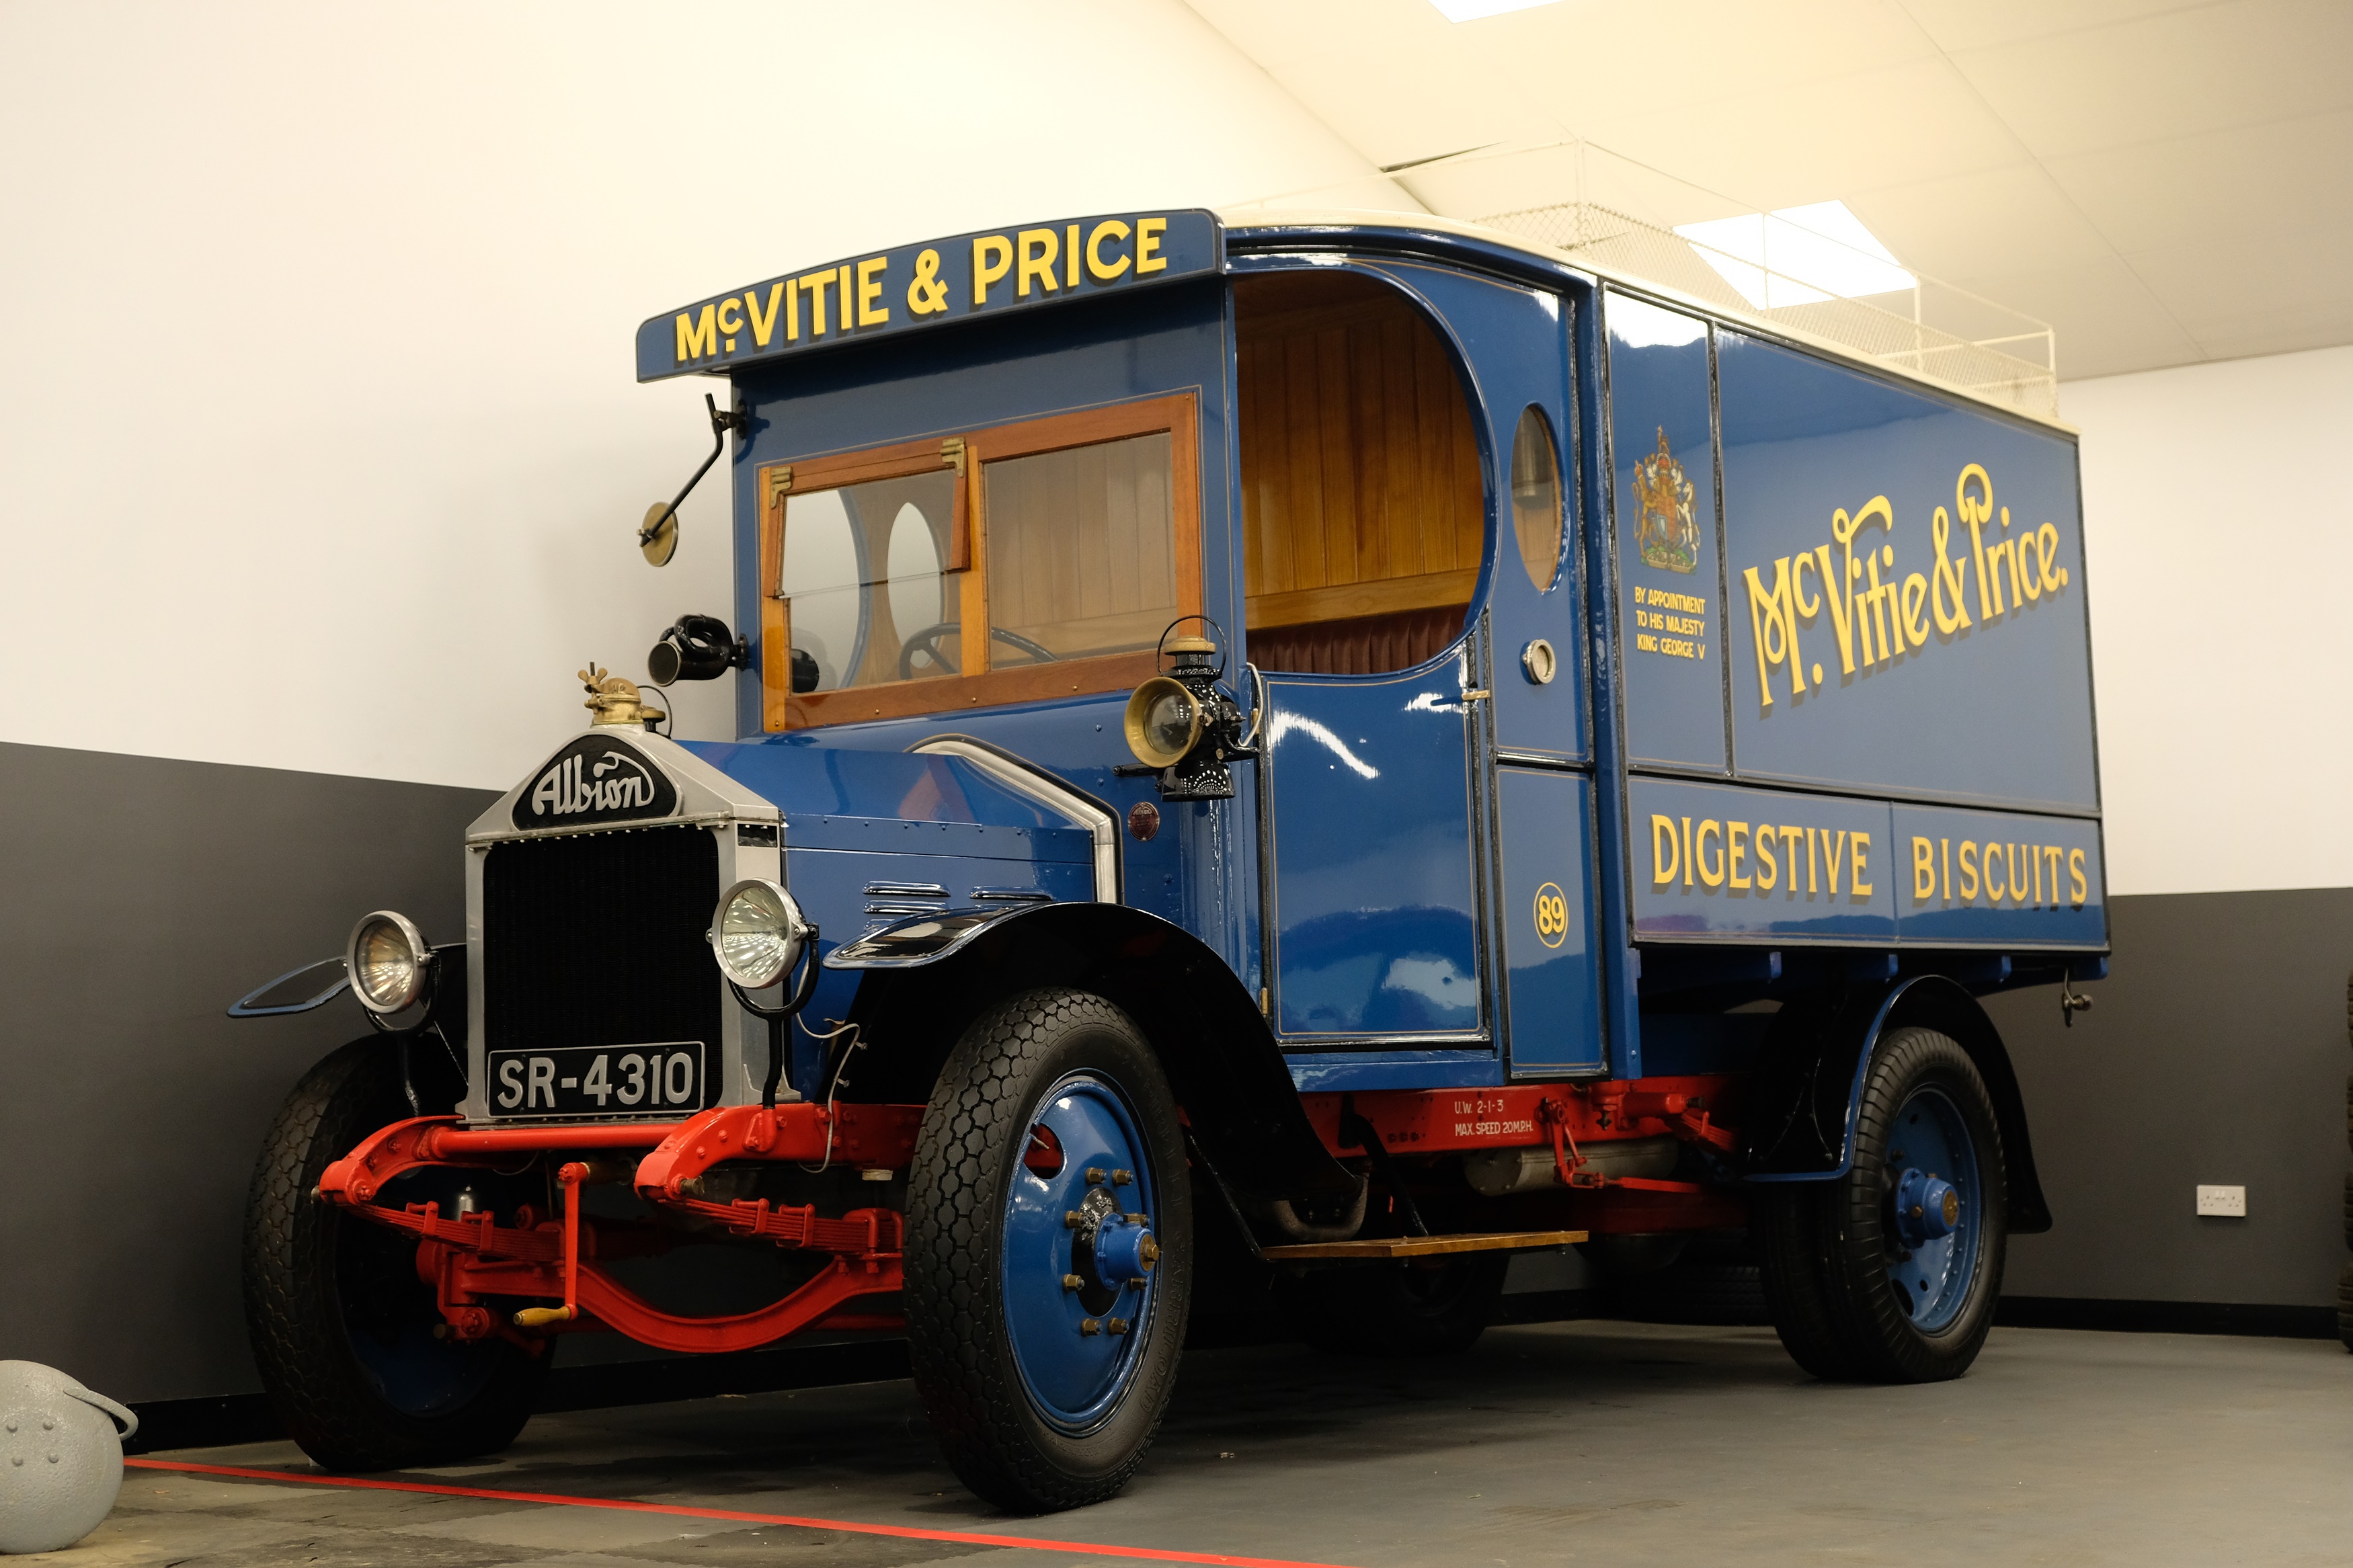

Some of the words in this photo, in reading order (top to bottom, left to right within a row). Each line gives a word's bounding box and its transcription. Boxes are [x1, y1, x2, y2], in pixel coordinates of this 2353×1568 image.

[908, 249, 948, 315] &
[973, 218, 1167, 304] PRICE
[1931, 506, 1972, 635] &
[1635, 586, 1646, 604] BY
[1648, 589, 1706, 614] APPOINTMENT
[1636, 610, 1647, 626] TO
[1649, 612, 1664, 630] HIS
[1666, 615, 1705, 636] MAJESTY
[1637, 634, 1658, 652] KING
[1661, 638, 1693, 658] GEORGE
[1698, 643, 1706, 659] V
[532, 751, 655, 815] Albion
[1651, 814, 1873, 896] DIGESTIVE
[1912, 836, 2087, 904] BISCUITS
[1539, 895, 1565, 935] 89
[497, 1052, 693, 1108] SR-4310
[1454, 1101, 1473, 1114] U.W.
[1455, 1122, 1475, 1137] MAX.
[1476, 1121, 1501, 1135] SPEED
